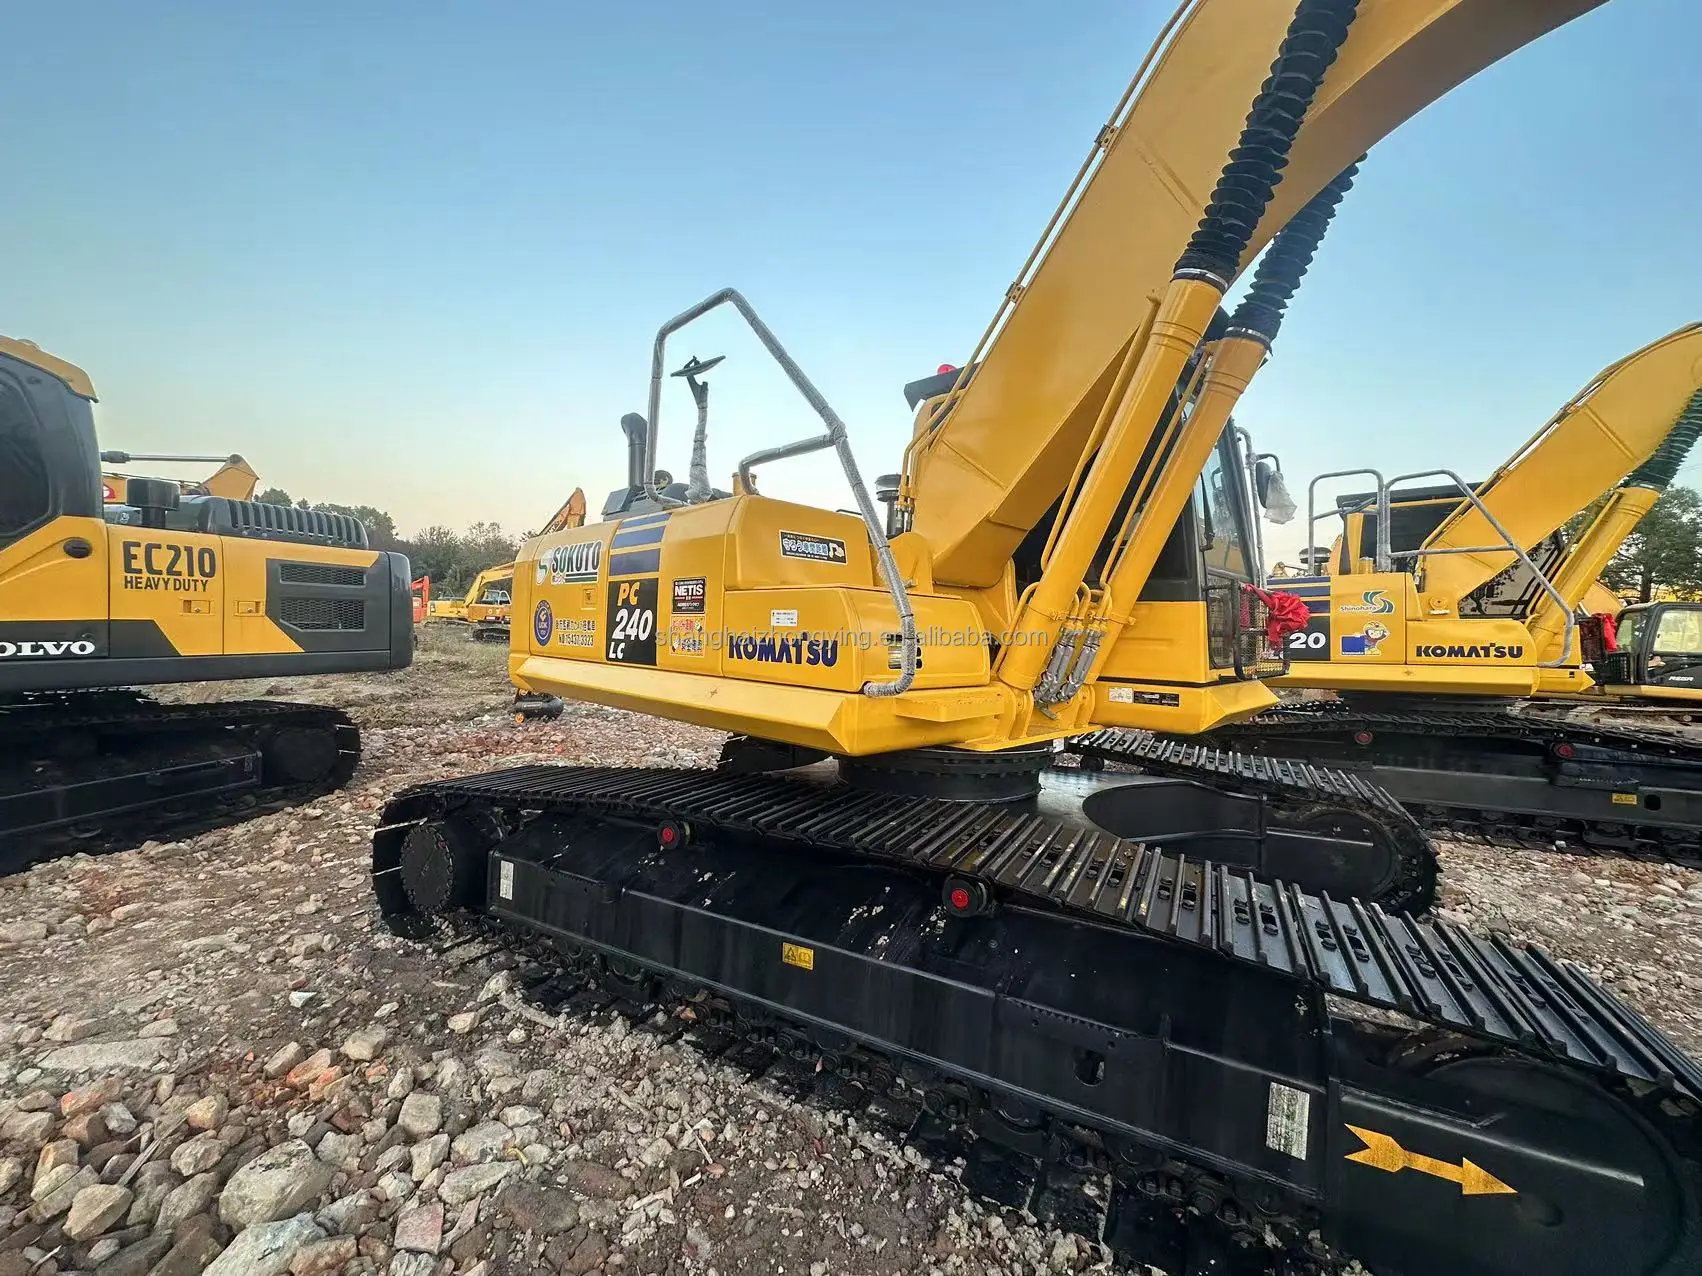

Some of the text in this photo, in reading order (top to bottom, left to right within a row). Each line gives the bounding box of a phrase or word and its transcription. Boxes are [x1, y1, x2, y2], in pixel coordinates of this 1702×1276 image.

[122, 540, 216, 579] EC210
[552, 541, 602, 573] SOKUTO
[124, 575, 208, 592] HEAVY DUTY
[617, 582, 640, 606] PC
[674, 584, 704, 596] NETIS
[612, 608, 653, 641] 240
[608, 641, 626, 659] LC
[728, 632, 838, 667] KOMATSU
[1416, 643, 1523, 659] KOMATSU
